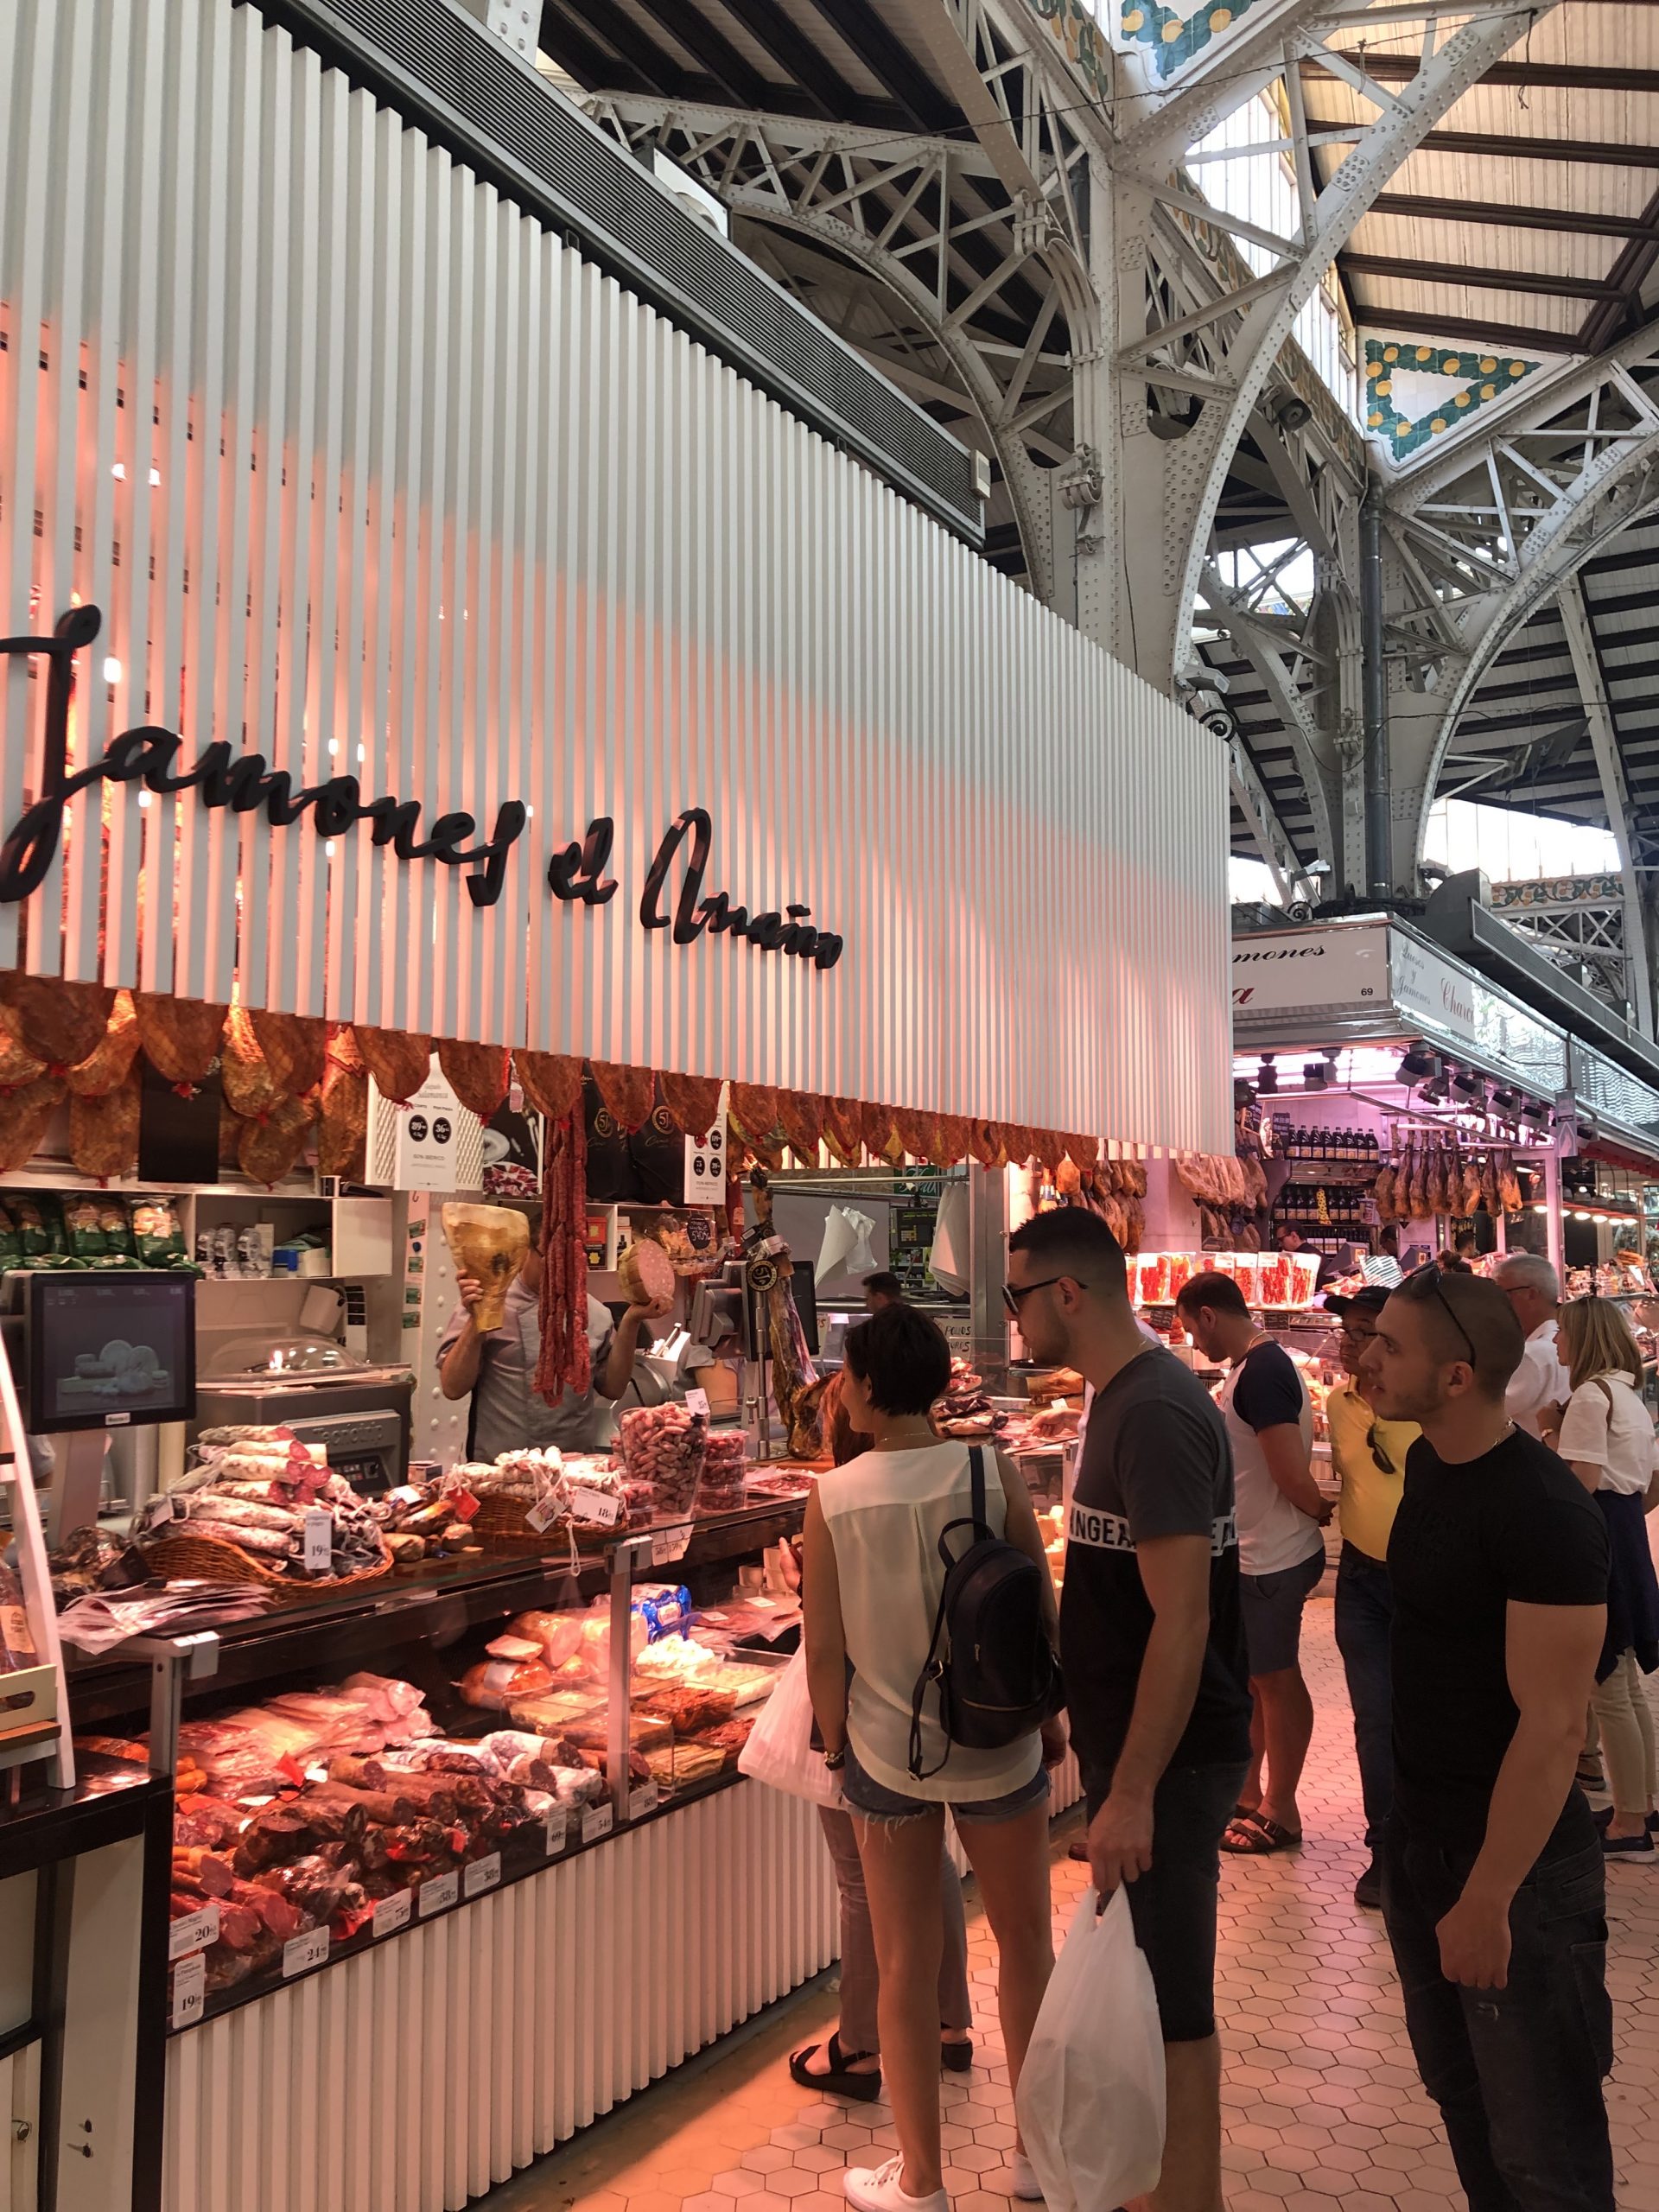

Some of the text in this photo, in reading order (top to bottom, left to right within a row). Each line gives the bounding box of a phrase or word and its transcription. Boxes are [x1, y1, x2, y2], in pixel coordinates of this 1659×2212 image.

[0, 604, 525, 907] Jamones
[548, 817, 619, 905] el
[1361, 988, 1374, 996] 69
